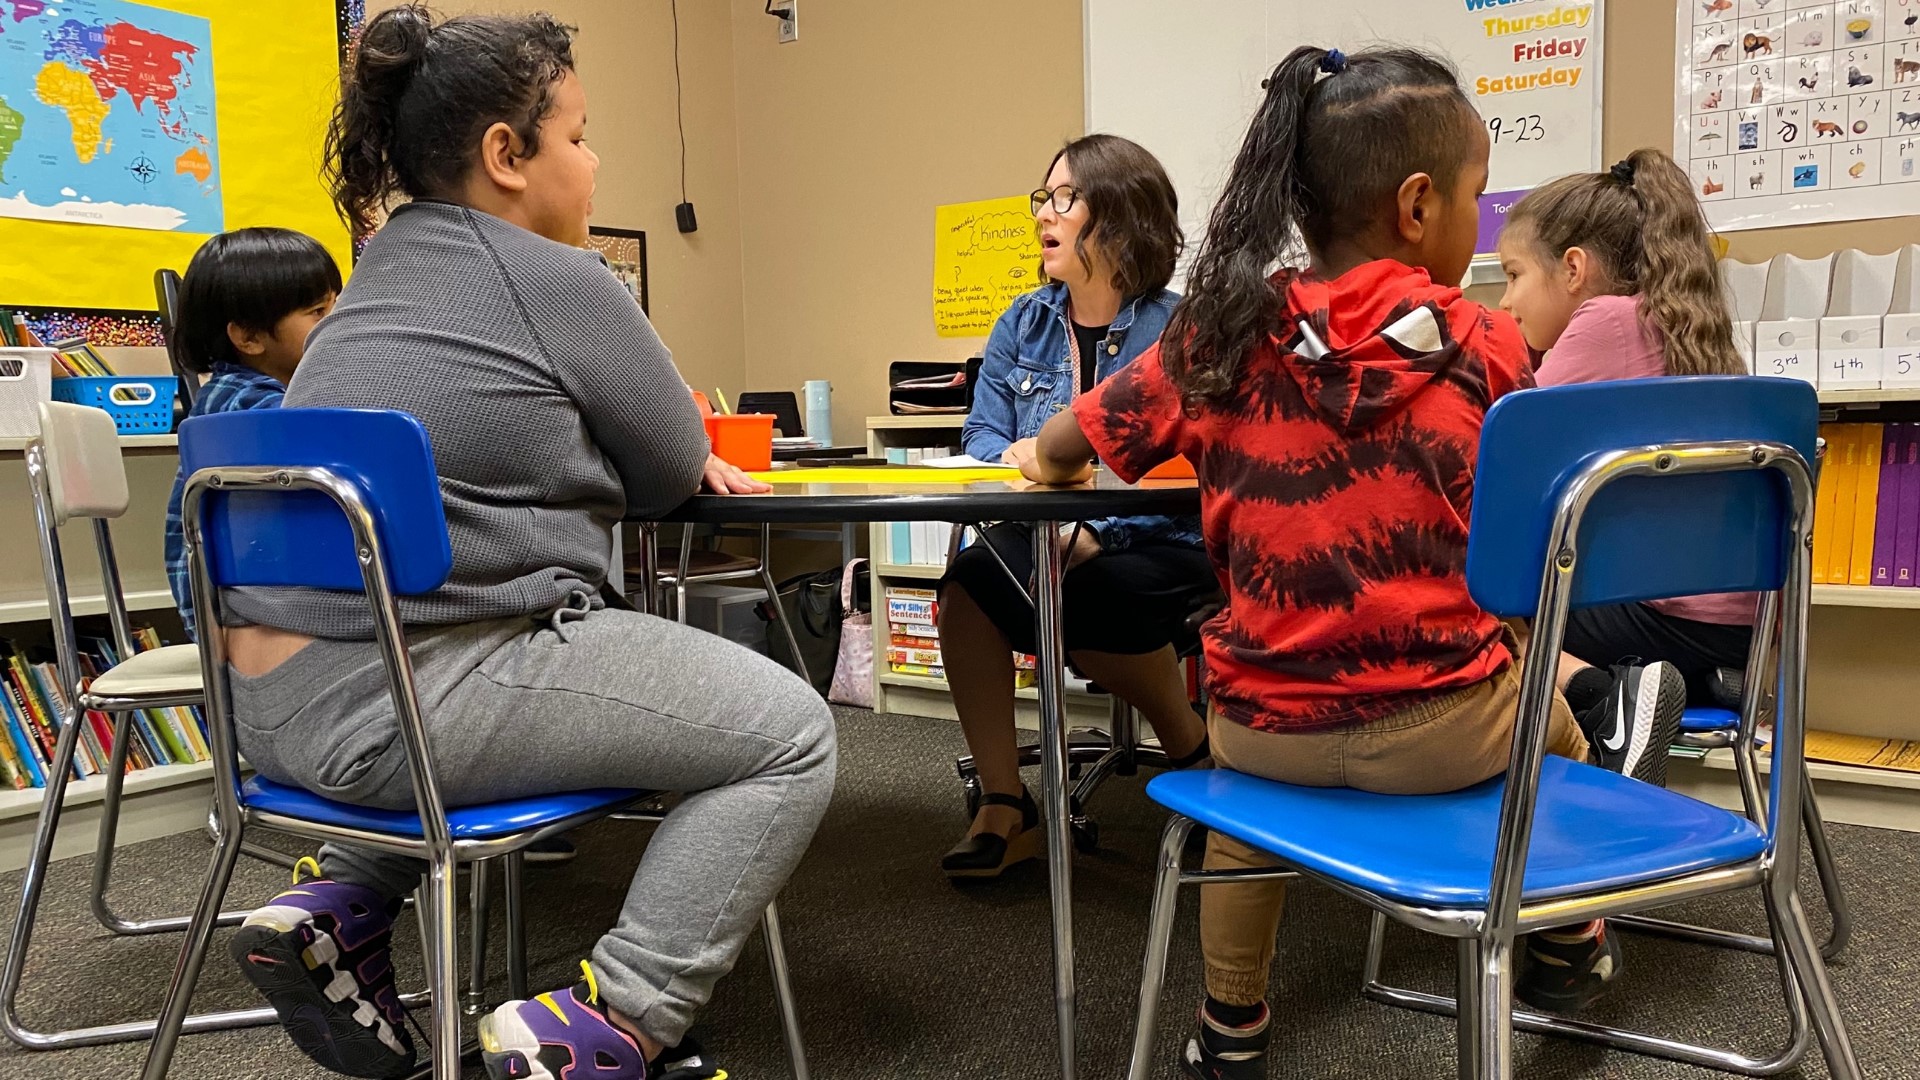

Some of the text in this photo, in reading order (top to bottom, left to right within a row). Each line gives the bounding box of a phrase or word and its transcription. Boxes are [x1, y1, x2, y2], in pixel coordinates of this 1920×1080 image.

[1849, 3, 1857, 14] N
[1483, 6, 1592, 37] Thursday
[1797, 11, 1807, 22] M
[1754, 19, 1759, 29] L
[1705, 25, 1725, 38] K k
[88, 31, 117, 46] EUROPE
[1514, 38, 1587, 62] Friday
[1901, 41, 1920, 55] T t
[1849, 51, 1855, 62] S
[1800, 58, 1807, 68] R
[138, 72, 156, 82] ASIA
[1750, 65, 1773, 79] Q q
[1476, 67, 1582, 95] Saturday
[1705, 72, 1723, 86] P p
[1902, 91, 1910, 102] Z
[1818, 101, 1826, 112] X
[1859, 96, 1880, 113] Y y
[1738, 111, 1746, 122] V
[1776, 107, 1784, 117] W
[1701, 116, 1708, 127] U
[1484, 115, 1545, 144] 9-23
[64, 210, 104, 219] ANTARCTICA
[1773, 354, 1798, 375] 3rd
[1834, 357, 1863, 379] 4th
[893, 588, 916, 596] Learning
[890, 601, 923, 613] Very Silly
[891, 610, 931, 619] Sentences
